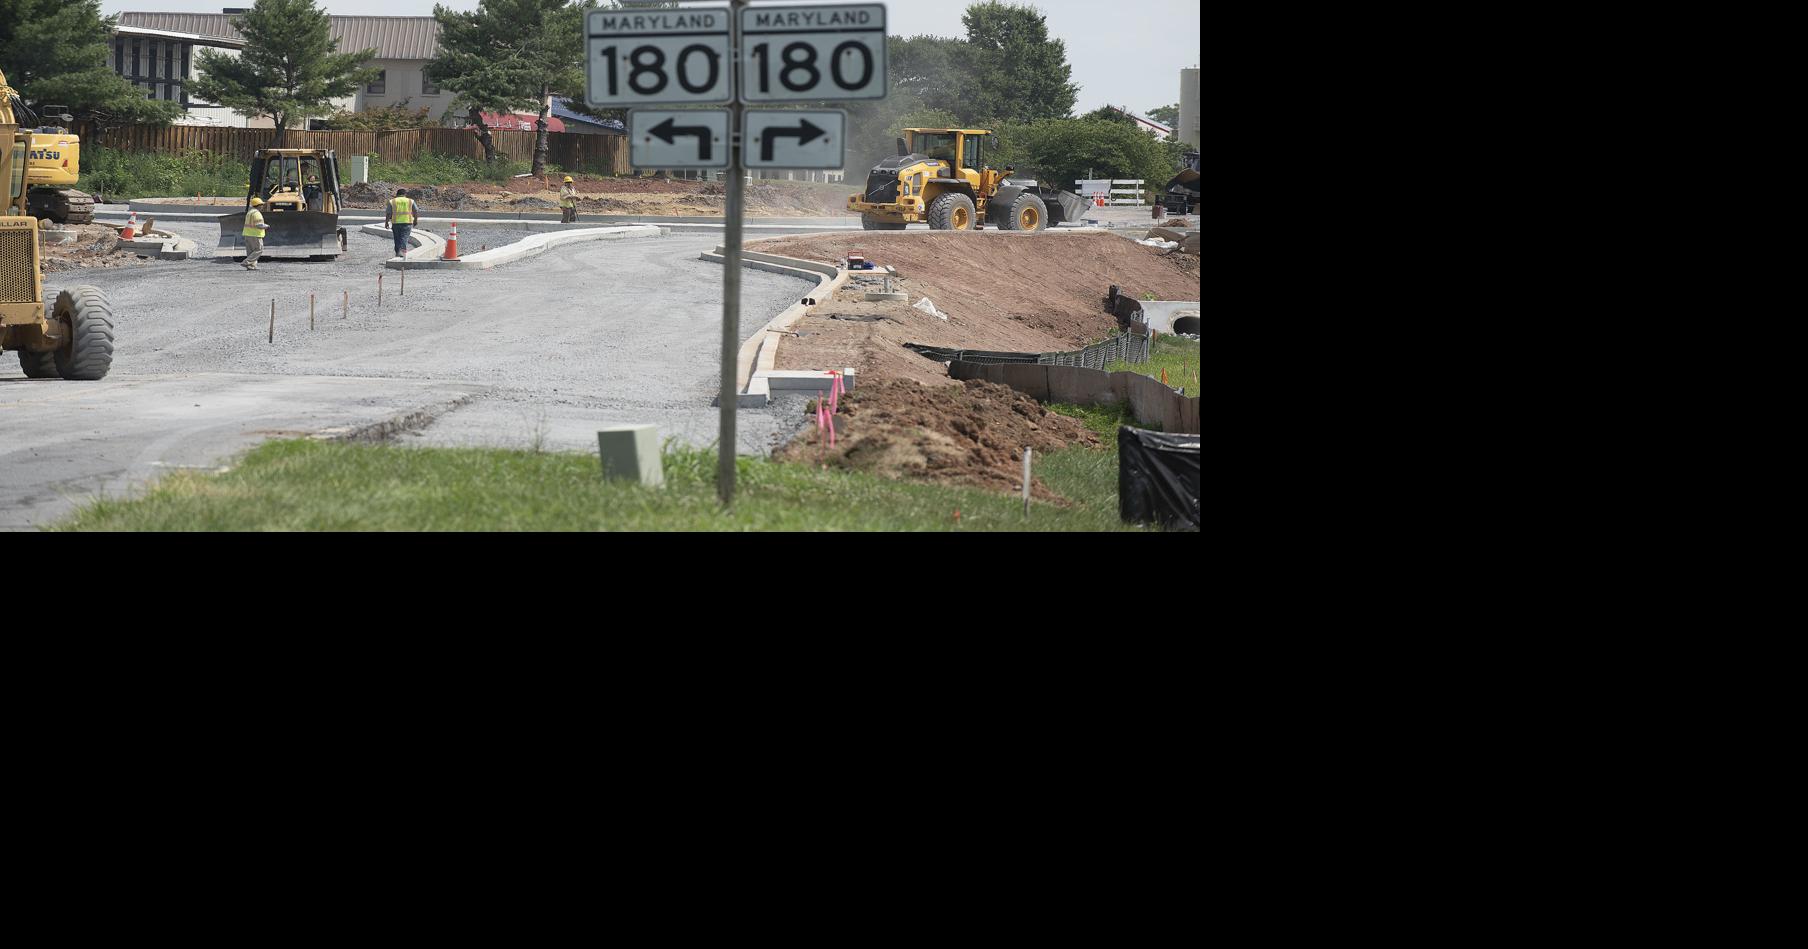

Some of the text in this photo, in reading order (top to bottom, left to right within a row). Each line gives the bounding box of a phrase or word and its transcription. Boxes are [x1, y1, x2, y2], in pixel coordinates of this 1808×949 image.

[602, 14, 716, 31] MARYLAND
[755, 11, 871, 27] MARYLAND
[601, 43, 720, 96] 180
[752, 40, 874, 93] 180
[29, 148, 60, 160] ATSU
